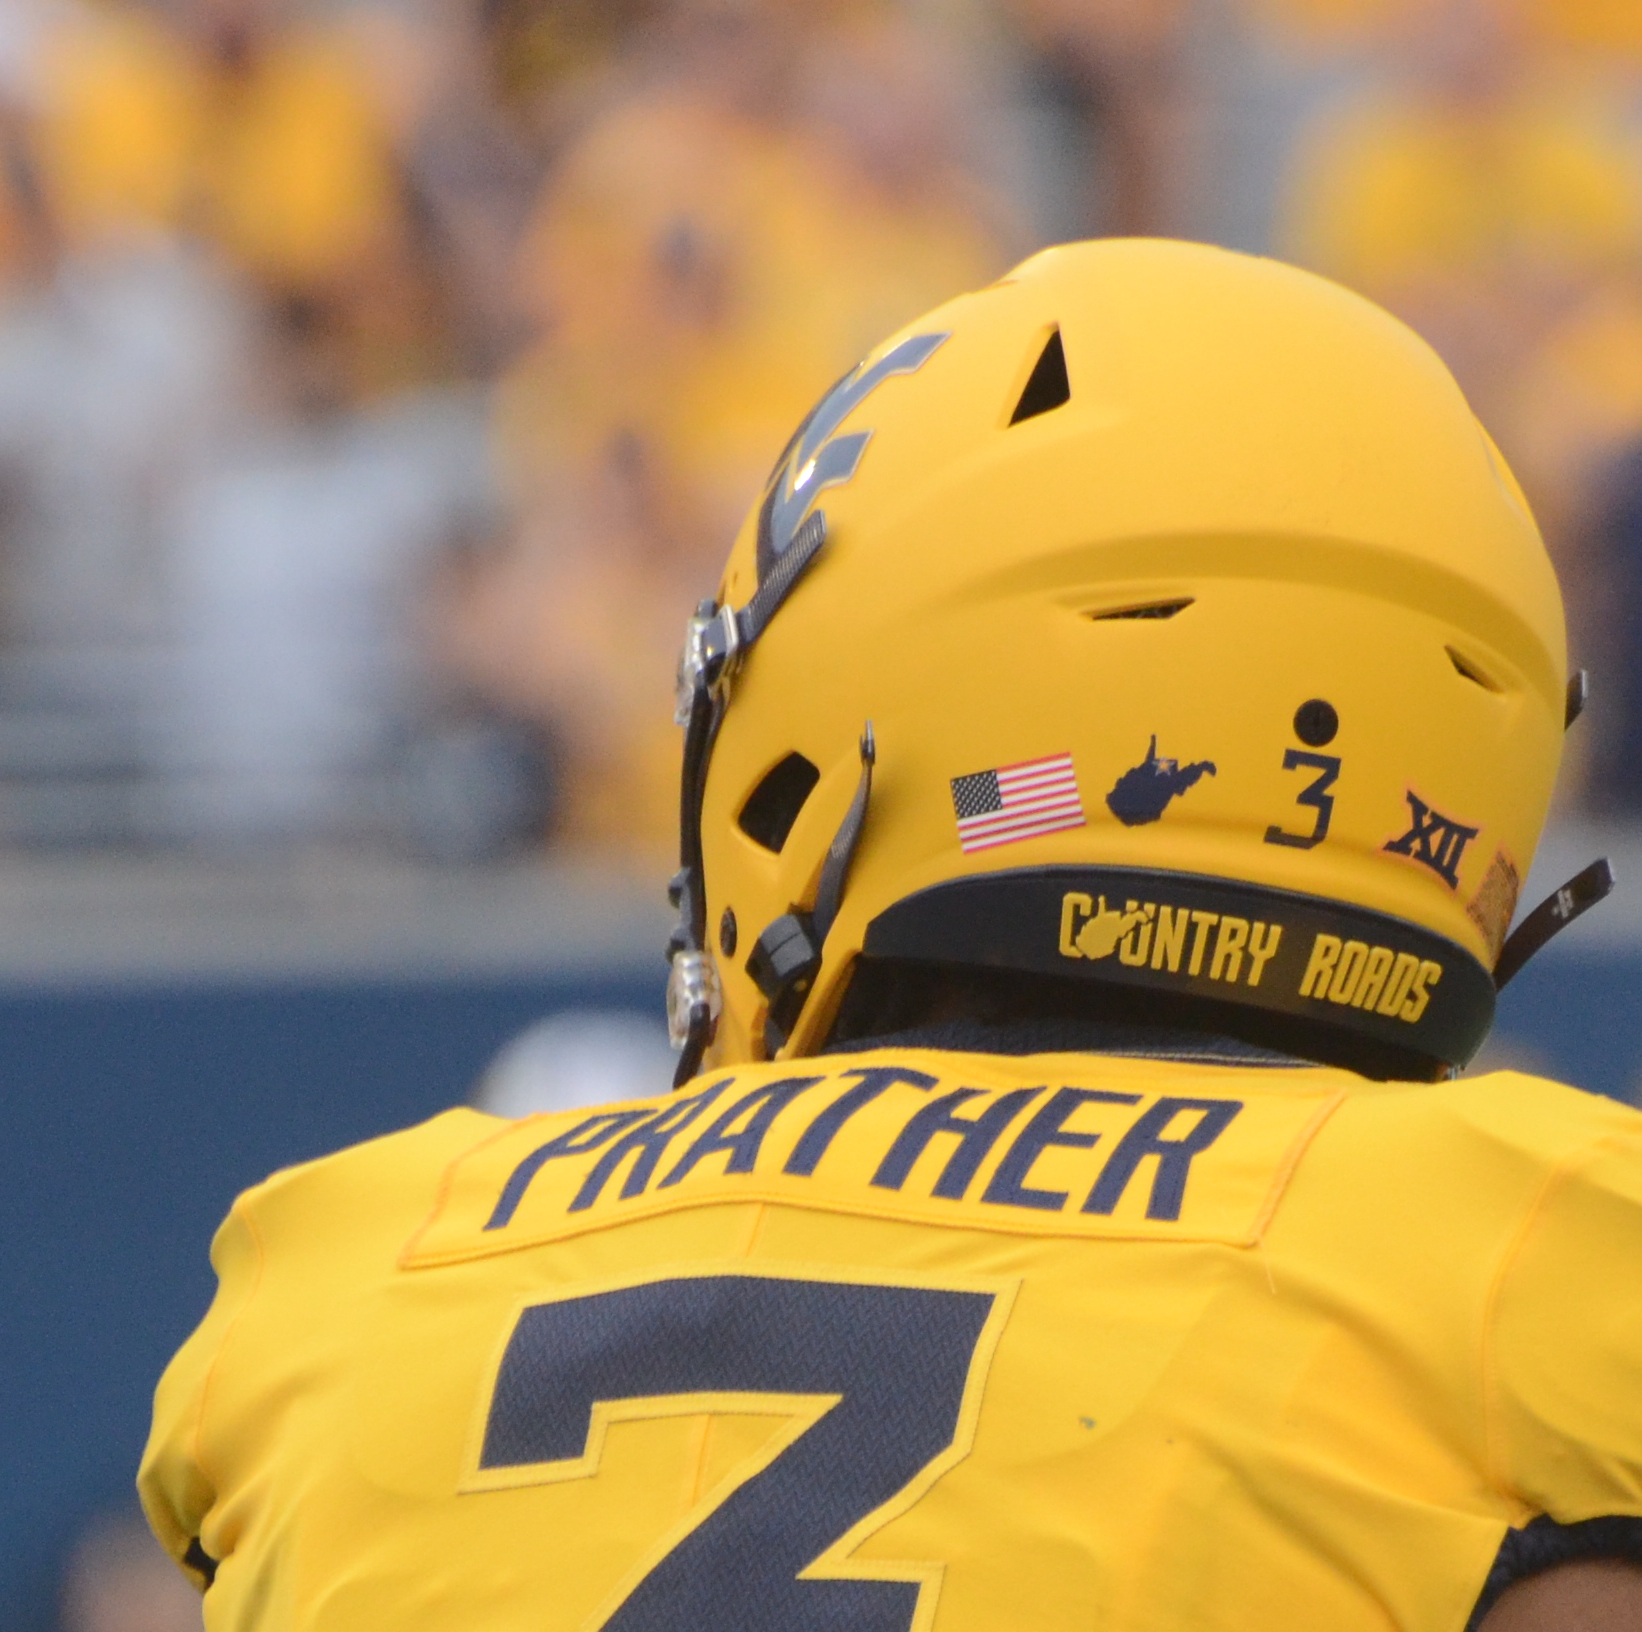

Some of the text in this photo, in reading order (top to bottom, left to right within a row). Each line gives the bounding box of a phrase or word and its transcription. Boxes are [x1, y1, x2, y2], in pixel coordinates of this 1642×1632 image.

[1264, 748, 1341, 850] 3
[1299, 933, 1443, 1023] ROADS
[483, 1066, 1243, 1231] PRATHER
